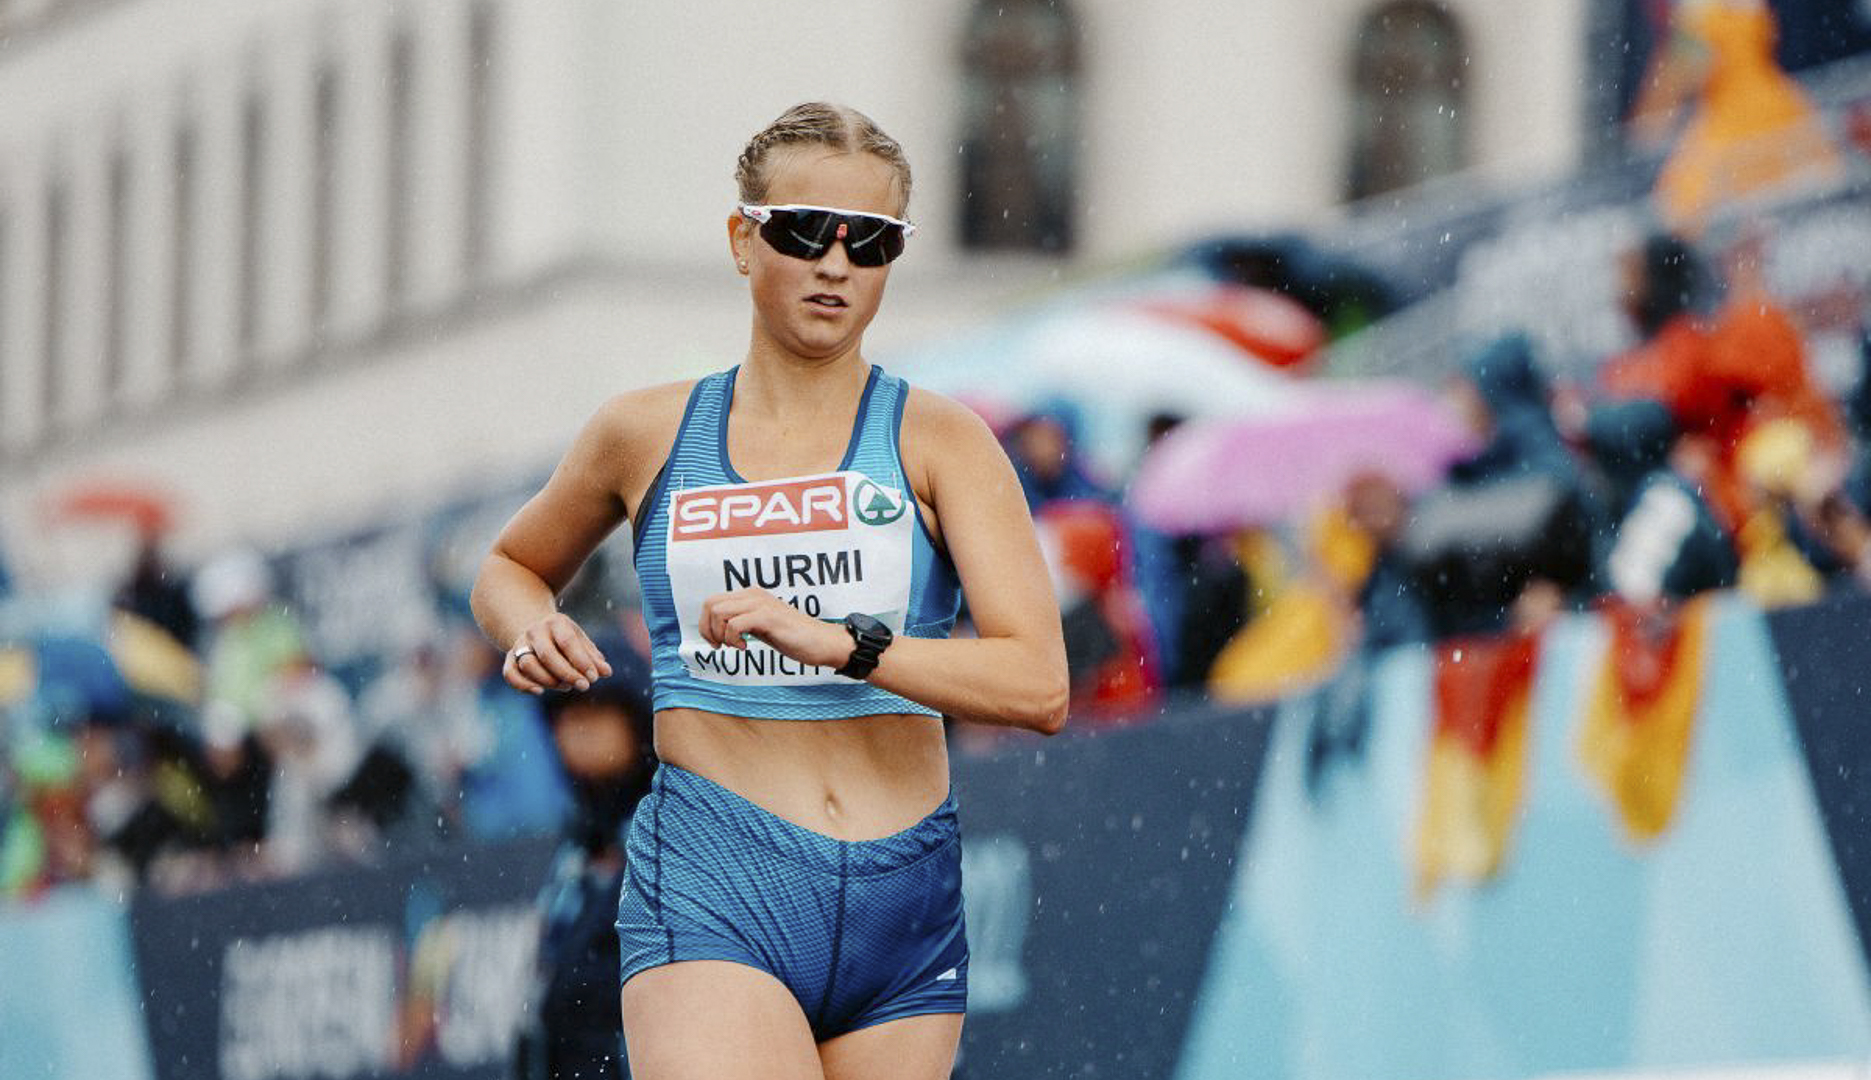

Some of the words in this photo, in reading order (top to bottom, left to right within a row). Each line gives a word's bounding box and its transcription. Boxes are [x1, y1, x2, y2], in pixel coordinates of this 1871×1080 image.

[679, 485, 843, 533] SPAR
[722, 549, 863, 592] NURMI
[777, 594, 821, 618] 10
